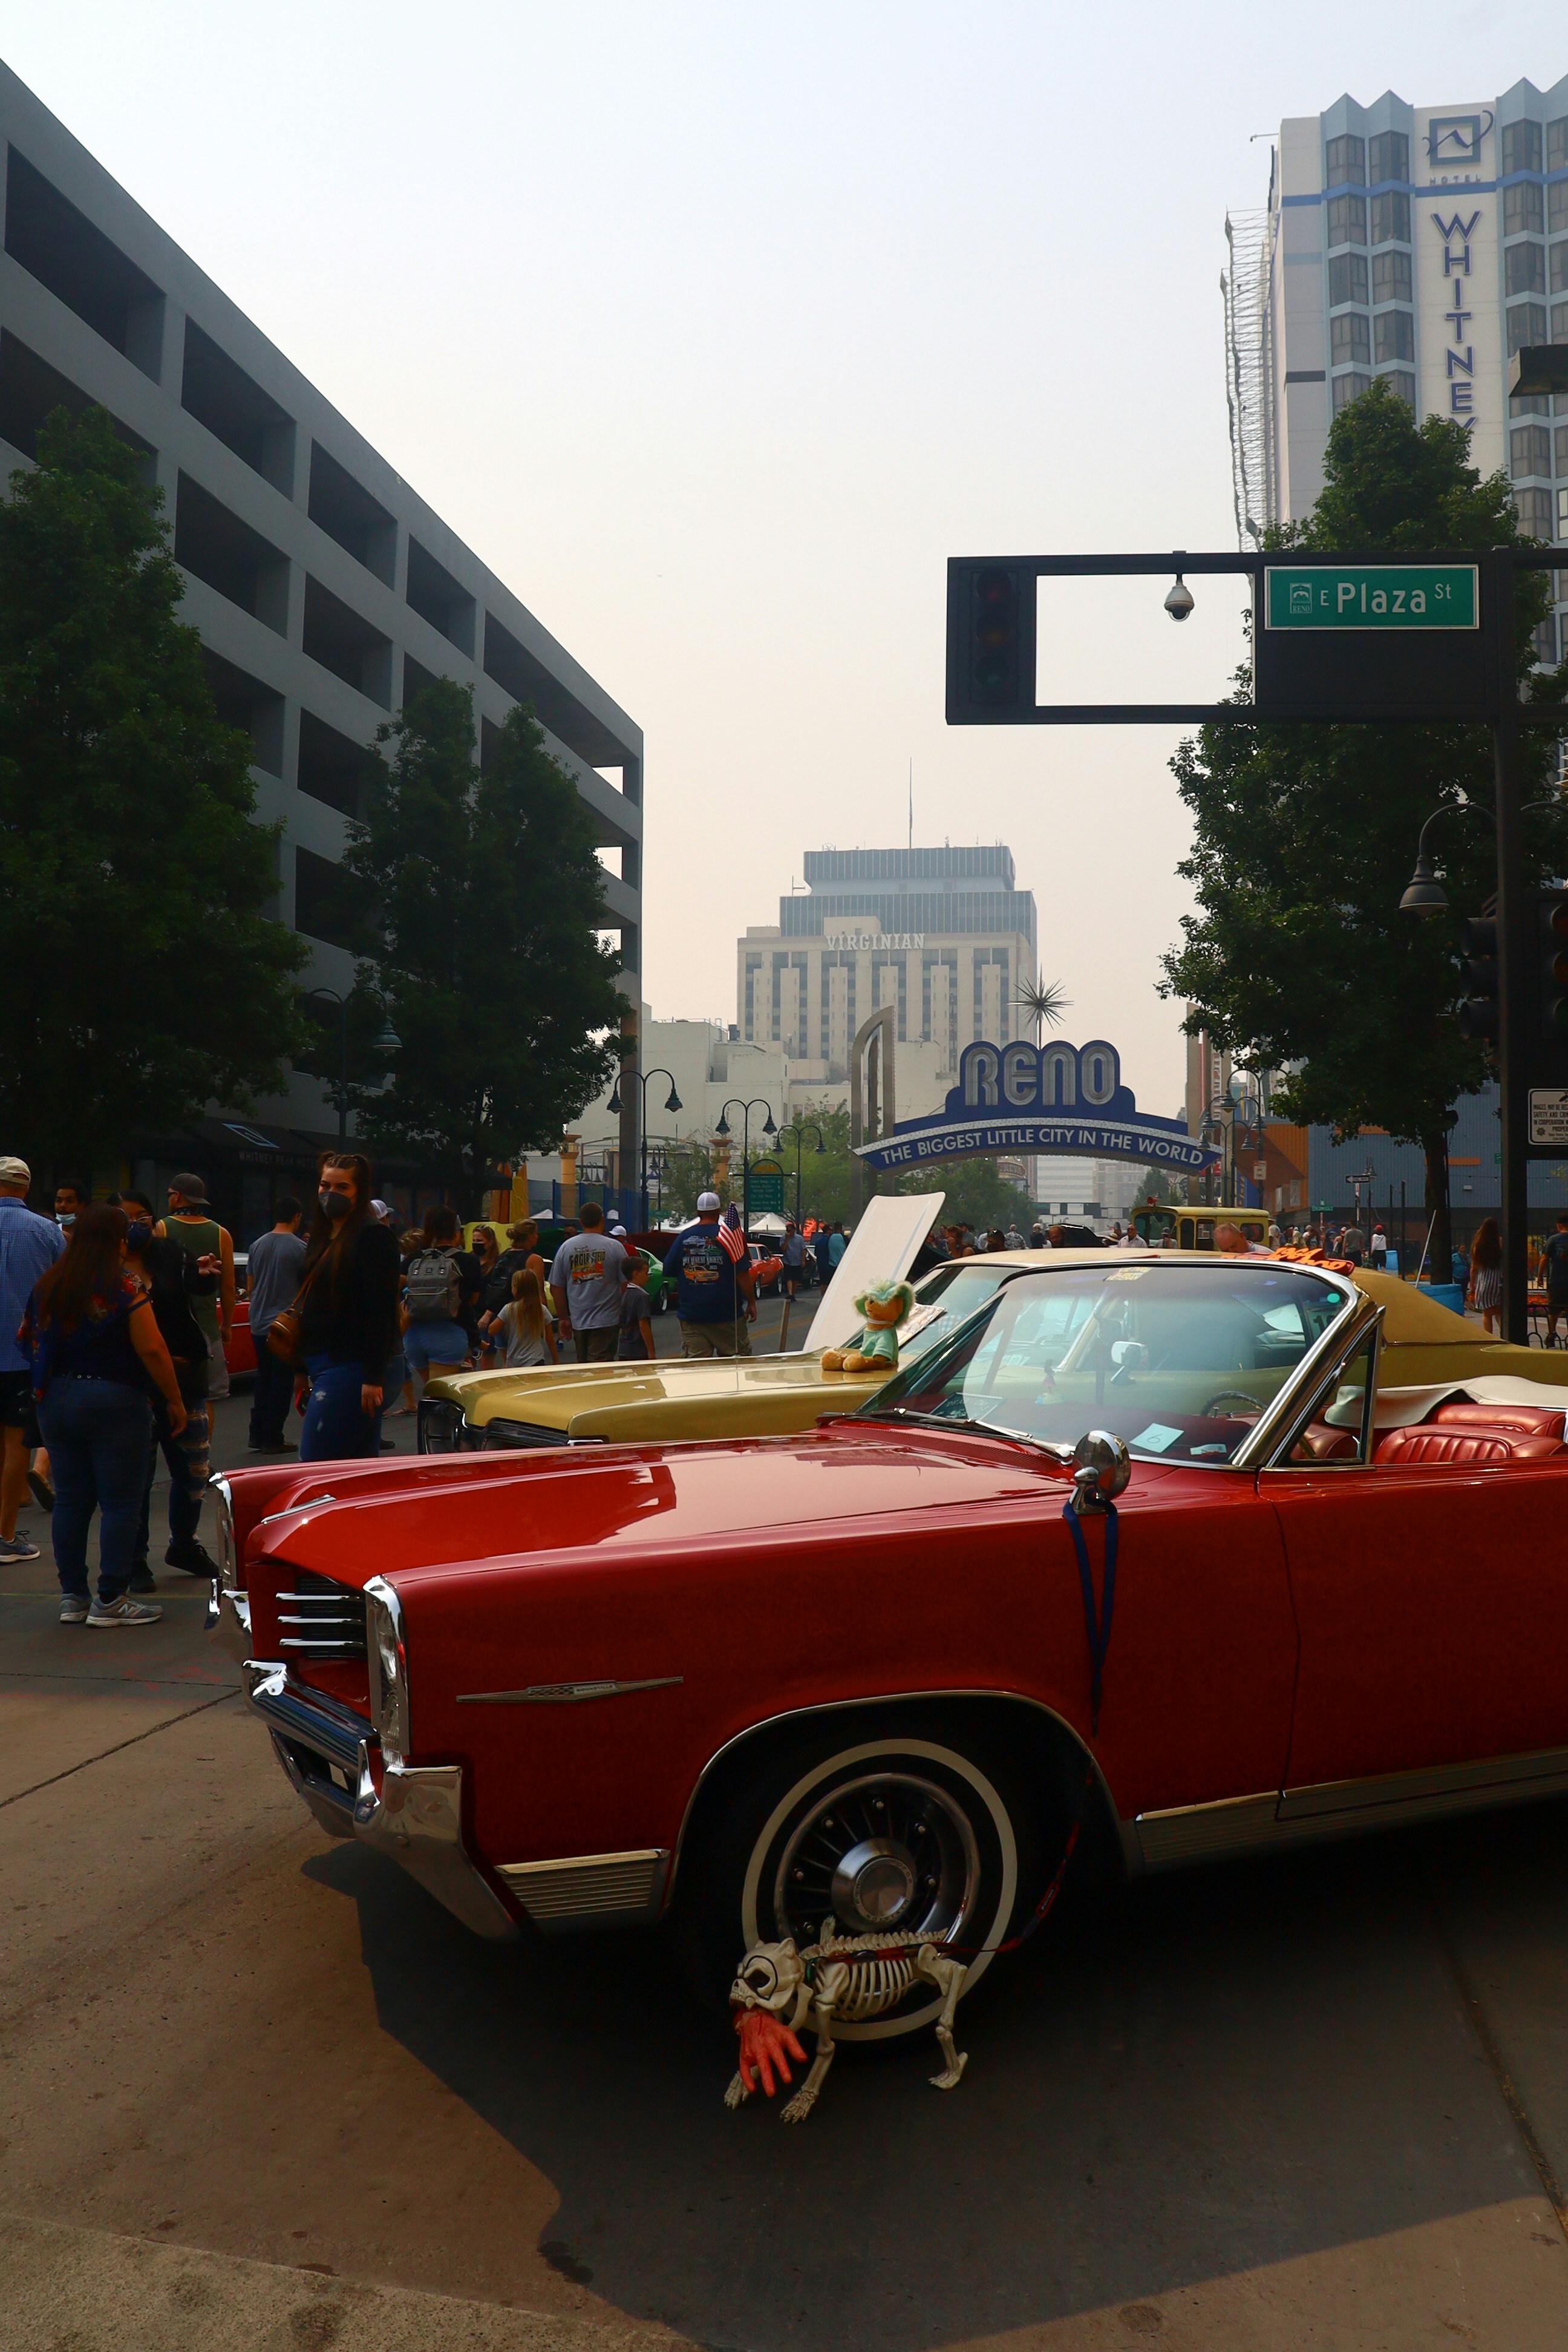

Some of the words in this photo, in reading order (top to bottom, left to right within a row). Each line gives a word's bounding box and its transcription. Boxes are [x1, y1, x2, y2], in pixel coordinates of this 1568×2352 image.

[1429, 174, 1481, 186] HOTEL
[1321, 590, 1329, 606] E
[1337, 582, 1426, 613] Plaza
[1435, 583, 1451, 599] St
[826, 933, 925, 950] VIRGINIAN
[965, 1047, 1115, 1106] RENO
[881, 1149, 913, 1165] THE
[917, 1132, 982, 1156] BIGGEST
[987, 1129, 1034, 1145] LITTLE
[1039, 1128, 1075, 1144] CITY
[1078, 1129, 1096, 1145] IN
[1101, 1132, 1132, 1149] THE
[1138, 1137, 1203, 1165] WORLD
[296, 1157, 316, 1169] HOTE
